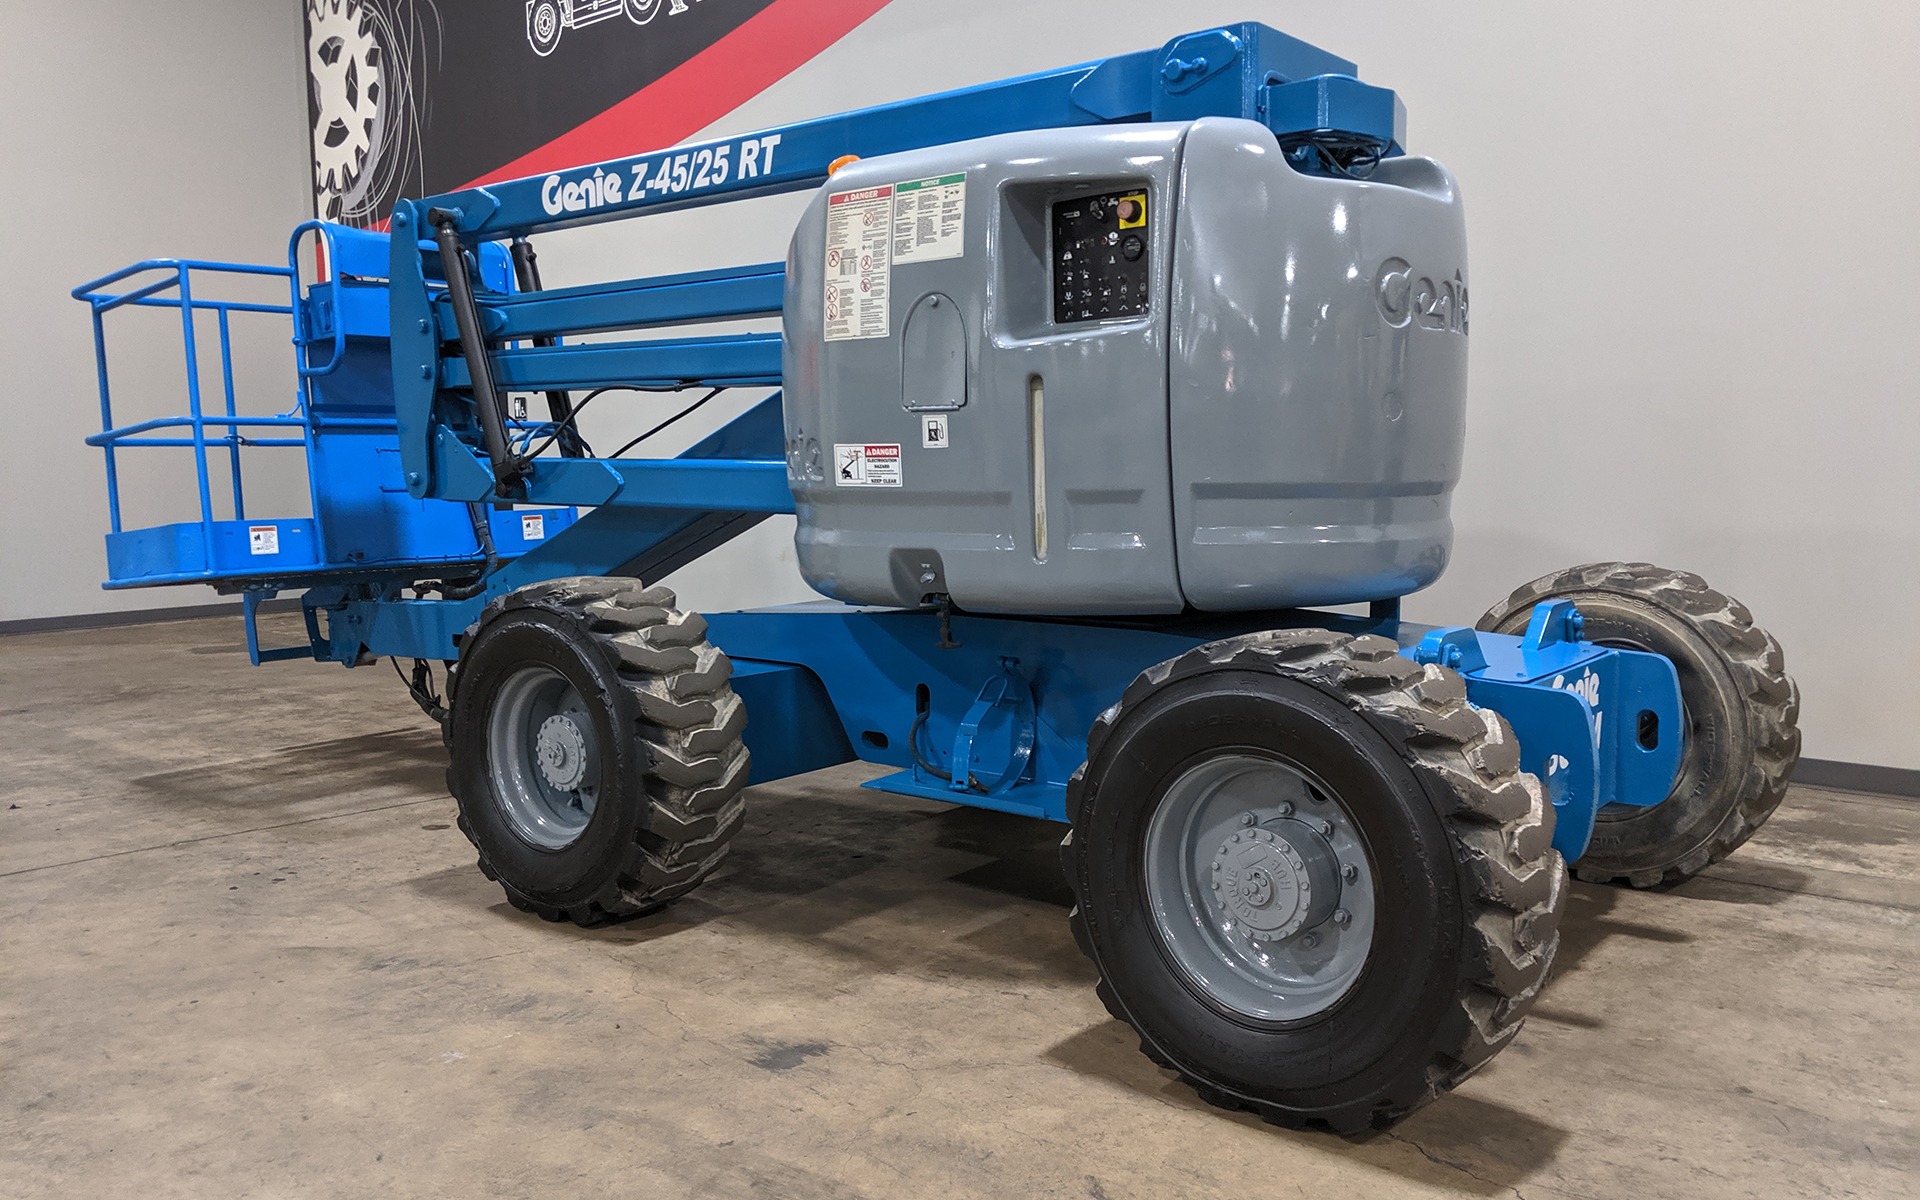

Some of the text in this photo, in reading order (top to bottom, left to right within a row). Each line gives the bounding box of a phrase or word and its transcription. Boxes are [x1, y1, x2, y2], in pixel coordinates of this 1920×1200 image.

[541, 134, 782, 216] Genie Z-45/25 RT
[920, 179, 940, 187] NOTICE
[850, 190, 878, 201] DANGER
[871, 448, 898, 456] DANGER
